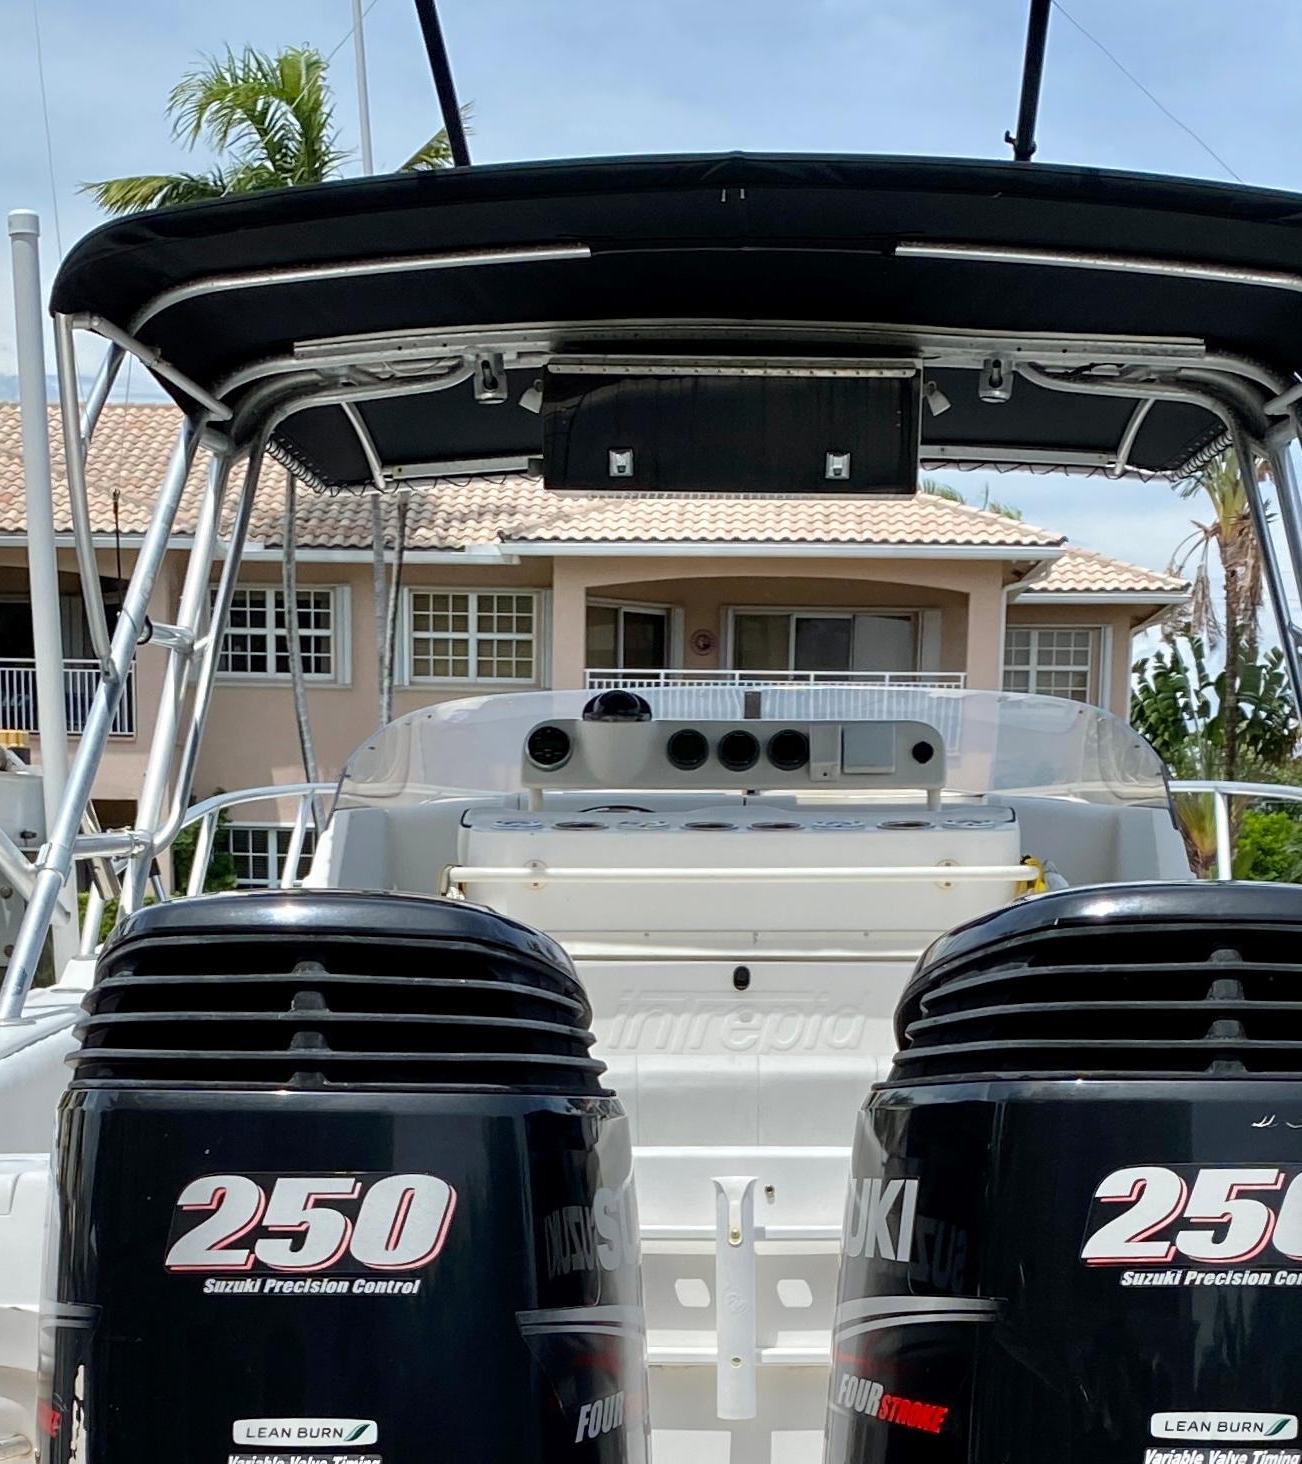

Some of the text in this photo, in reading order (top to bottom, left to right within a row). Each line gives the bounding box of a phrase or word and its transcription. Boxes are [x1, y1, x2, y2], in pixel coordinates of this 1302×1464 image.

[165, 1174, 457, 1272] 250
[1120, 1270, 1183, 1286] Suzuki
[1185, 1271, 1270, 1286] Precision
[203, 1278, 421, 1295] Suzuki Precision Control
[246, 1427, 344, 1439] LEAN BURN
[1164, 1420, 1264, 1433] LEAN BURN
